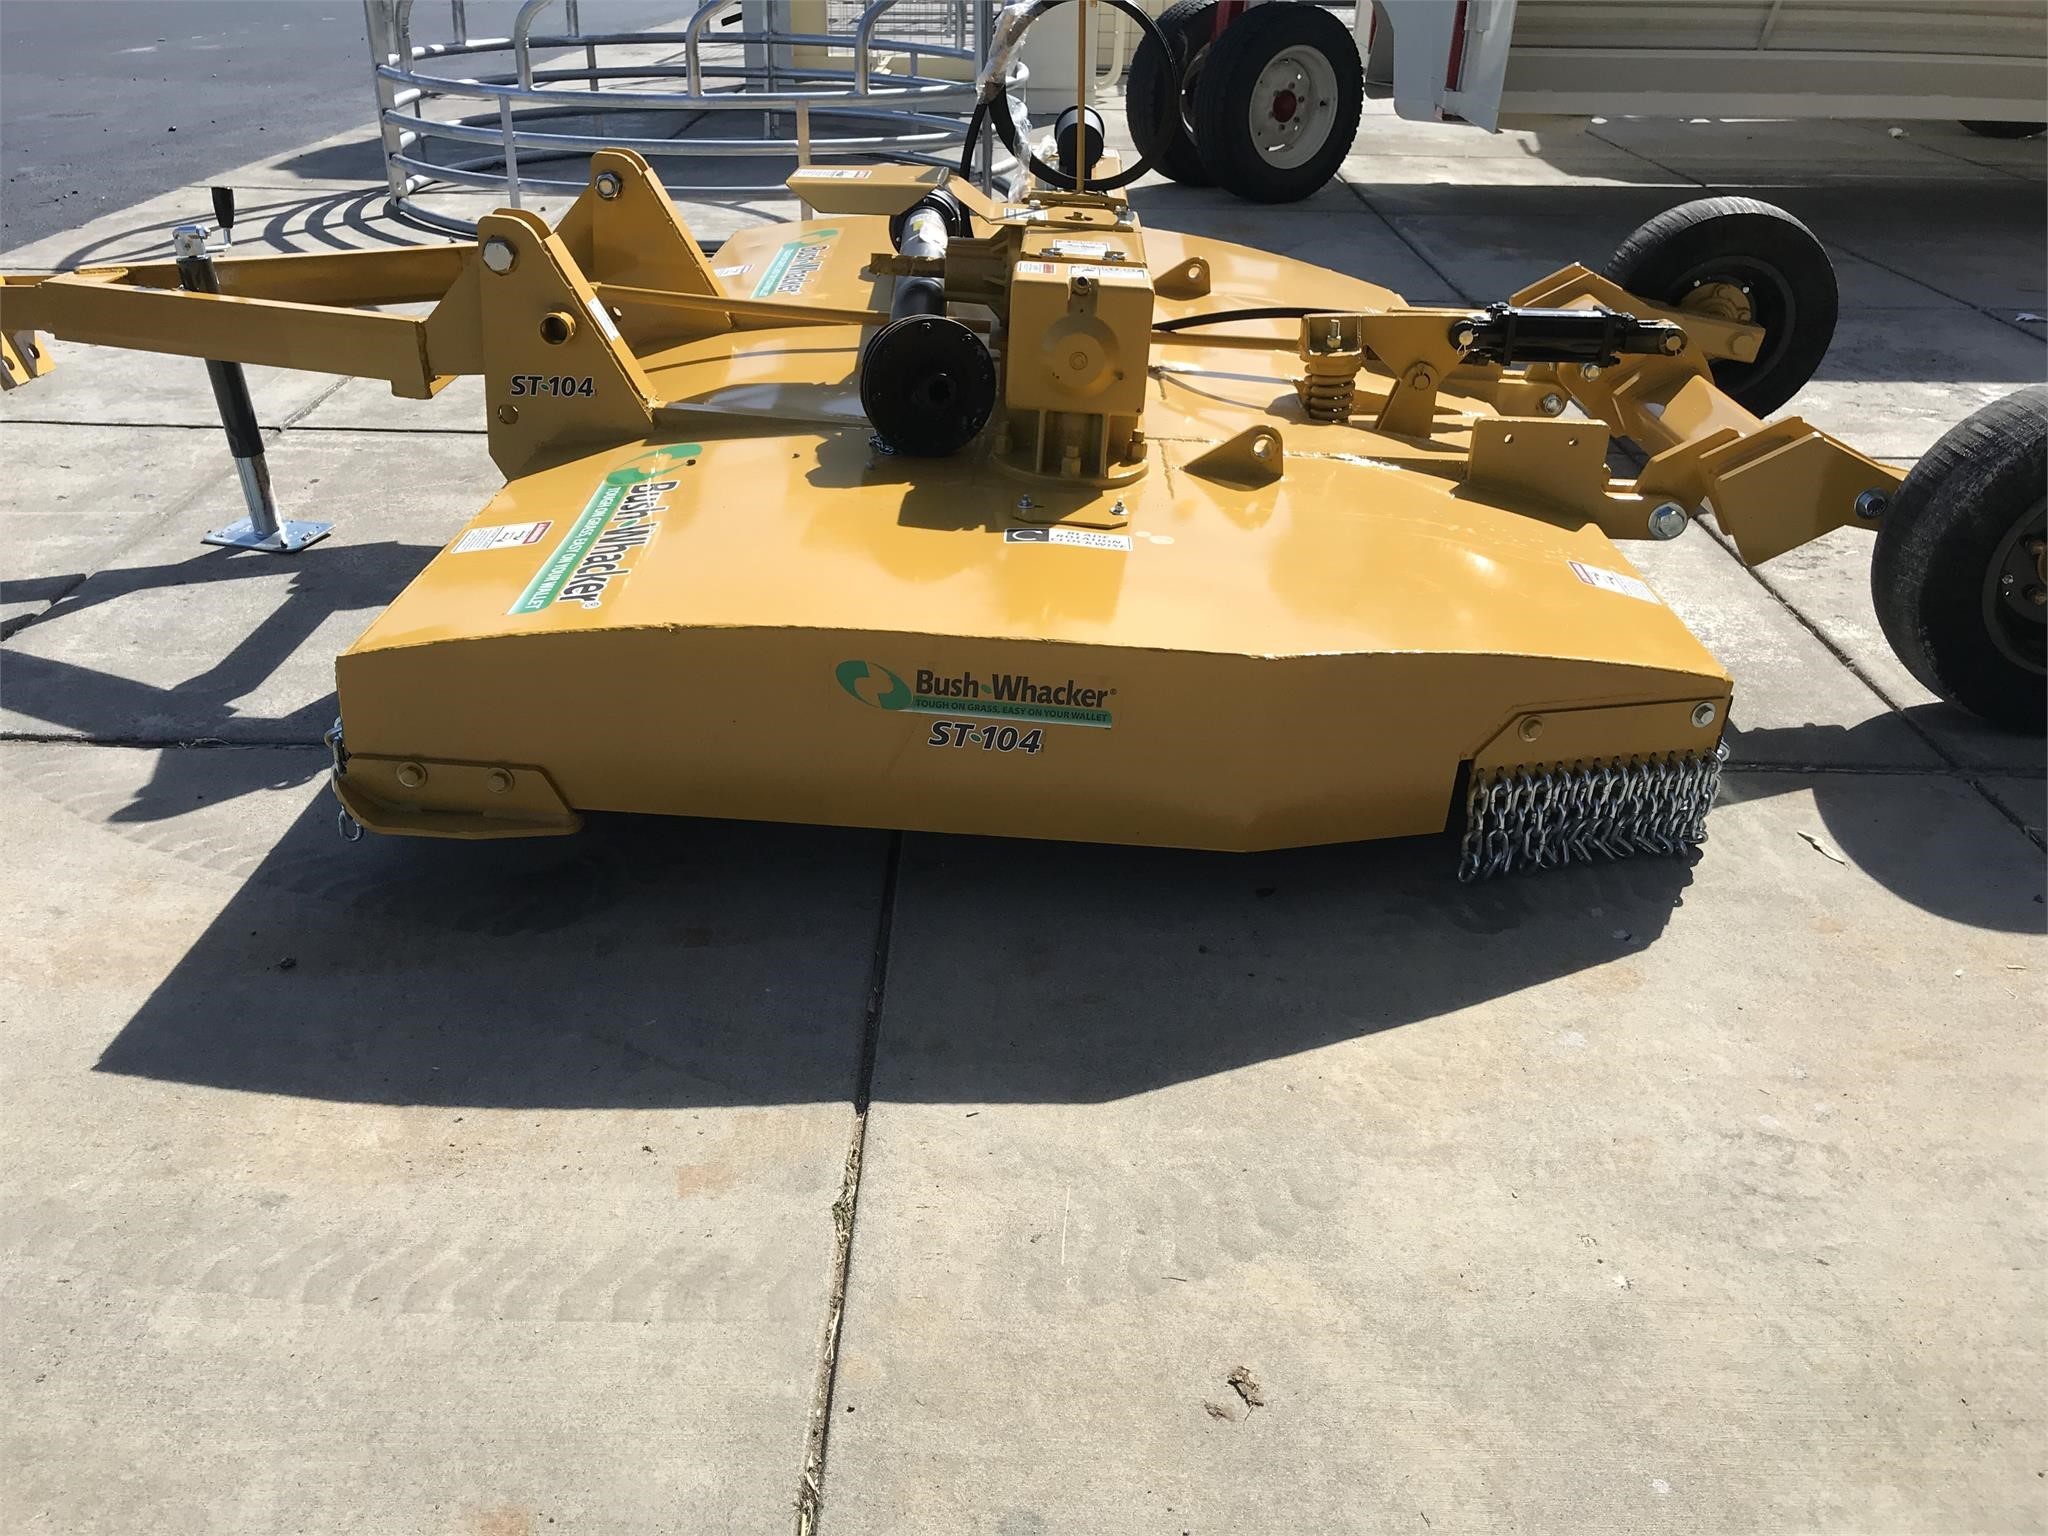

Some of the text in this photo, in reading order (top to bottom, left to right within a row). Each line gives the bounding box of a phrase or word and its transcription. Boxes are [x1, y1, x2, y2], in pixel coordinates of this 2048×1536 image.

[598, 487, 621, 508] TOUGH
[525, 580, 557, 609] WALLET
[916, 699, 1107, 722] TOUGH ON GRASS, EASY ON YOUR WALLET
